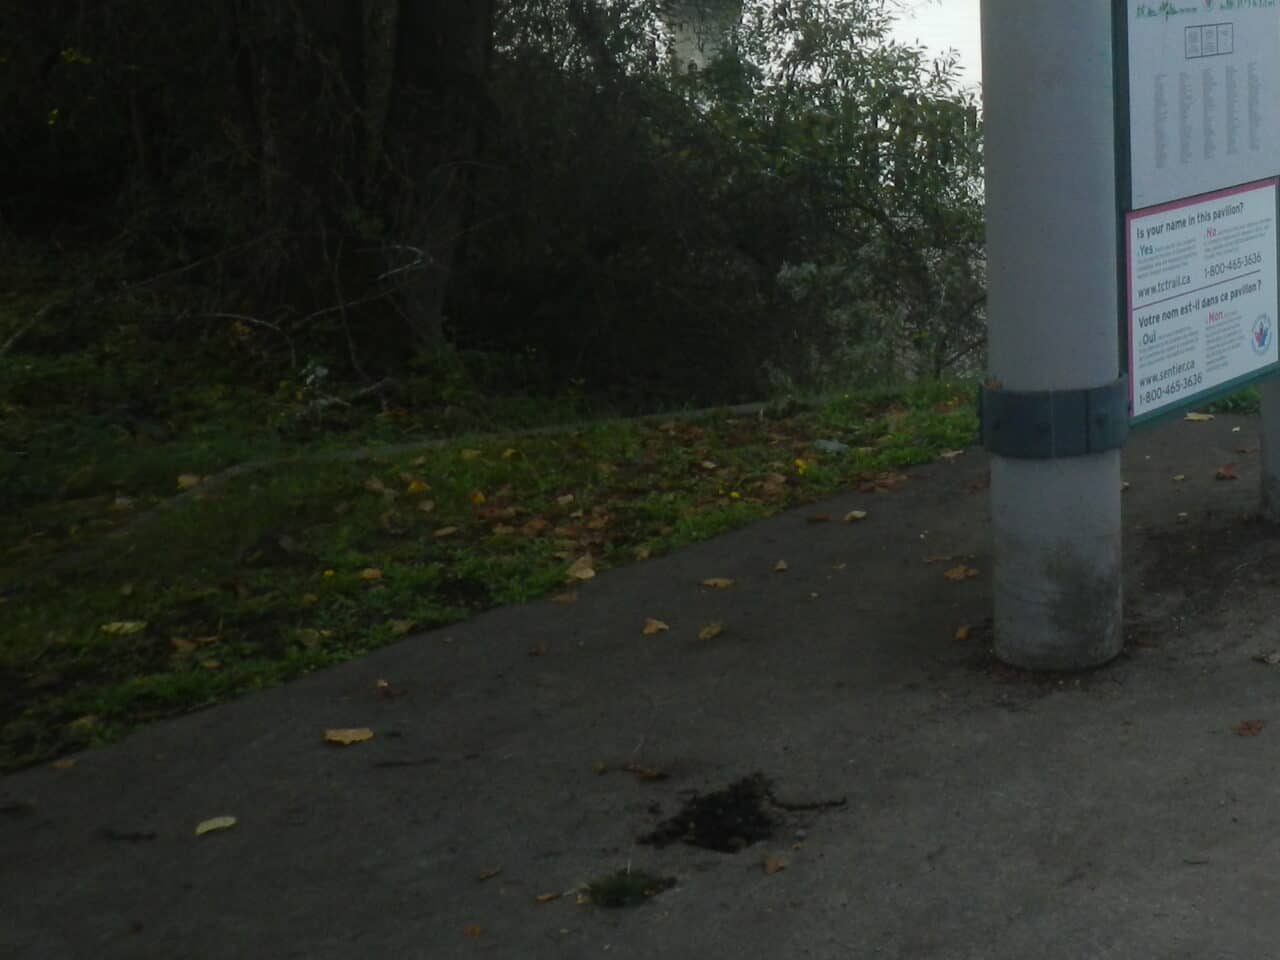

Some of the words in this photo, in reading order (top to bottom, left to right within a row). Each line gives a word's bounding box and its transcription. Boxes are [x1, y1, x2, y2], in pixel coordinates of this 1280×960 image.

[1136, 227, 1144, 239] Is
[1146, 223, 1164, 239] your
[1165, 219, 1187, 232] name
[1188, 215, 1196, 226] in
[1197, 211, 1212, 223] this
[1213, 202, 1244, 221] pavilion?
[1206, 226, 1217, 238] No
[1140, 244, 1154, 256] Yes
[1138, 313, 1160, 329] Votre
[1161, 308, 1179, 321] nom
[1180, 301, 1200, 316] est-il
[1201, 295, 1219, 309] dans
[1220, 292, 1229, 302] ce
[1208, 311, 1224, 323] Non
[1142, 330, 1157, 345] Oui
